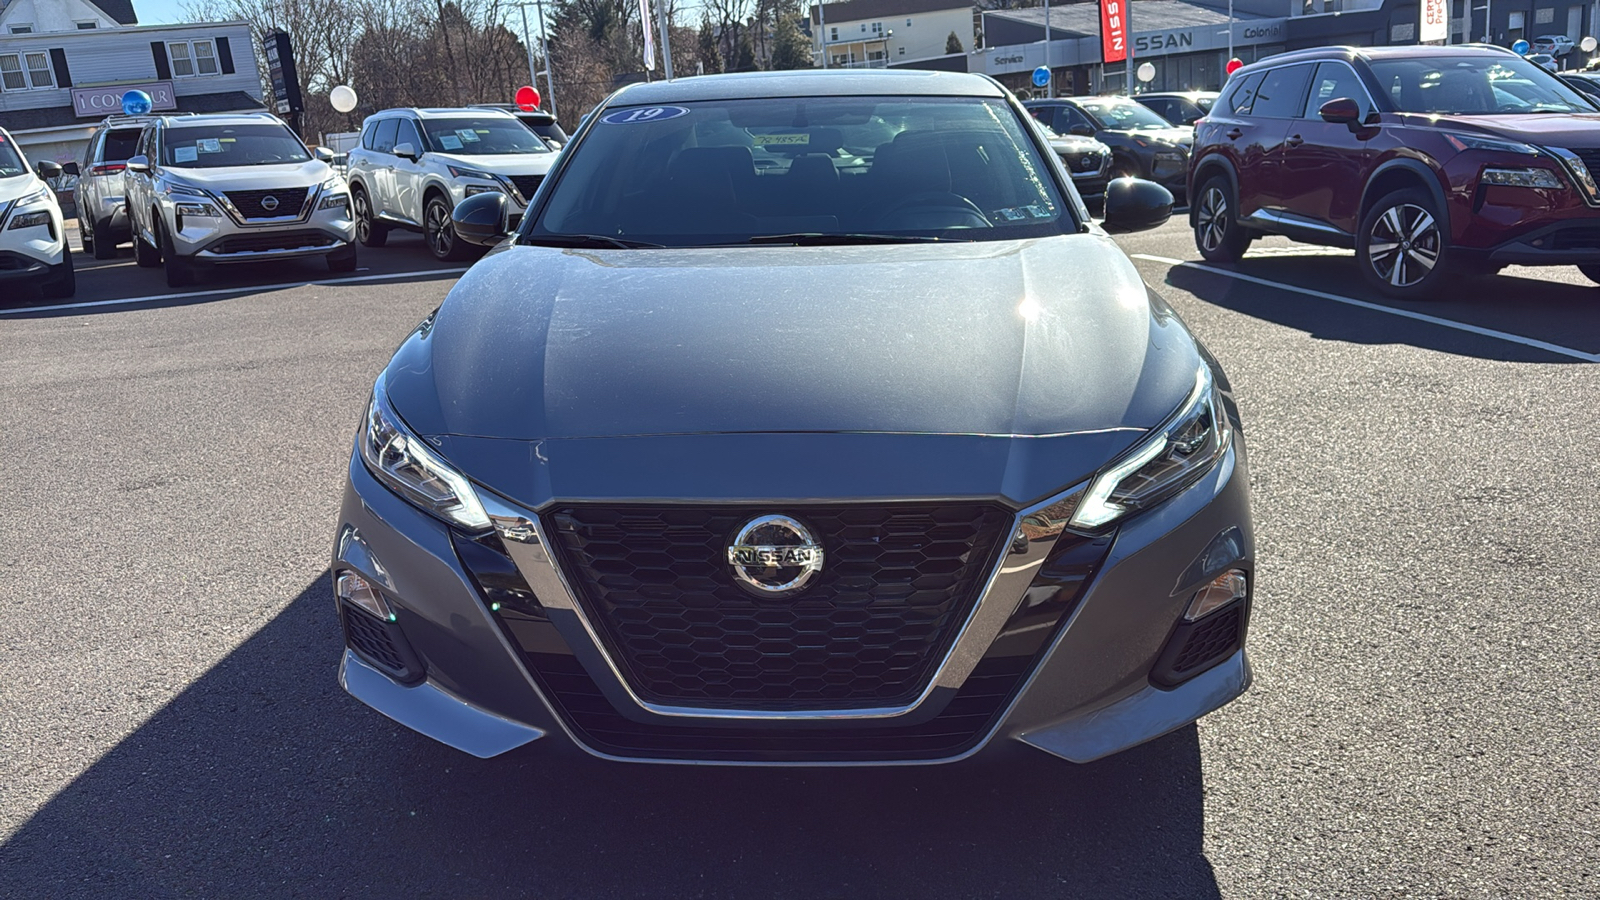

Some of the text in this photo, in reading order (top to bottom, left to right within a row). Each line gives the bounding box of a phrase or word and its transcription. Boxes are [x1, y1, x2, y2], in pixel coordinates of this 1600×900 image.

[1426, 0, 1434, 25] CERT
[1107, 2, 1124, 50] NISS
[1244, 24, 1282, 39] Colonial
[1135, 32, 1193, 51] SSAN
[994, 54, 1024, 65] Service
[622, 108, 664, 122] 19
[734, 549, 811, 563] NISSAN
